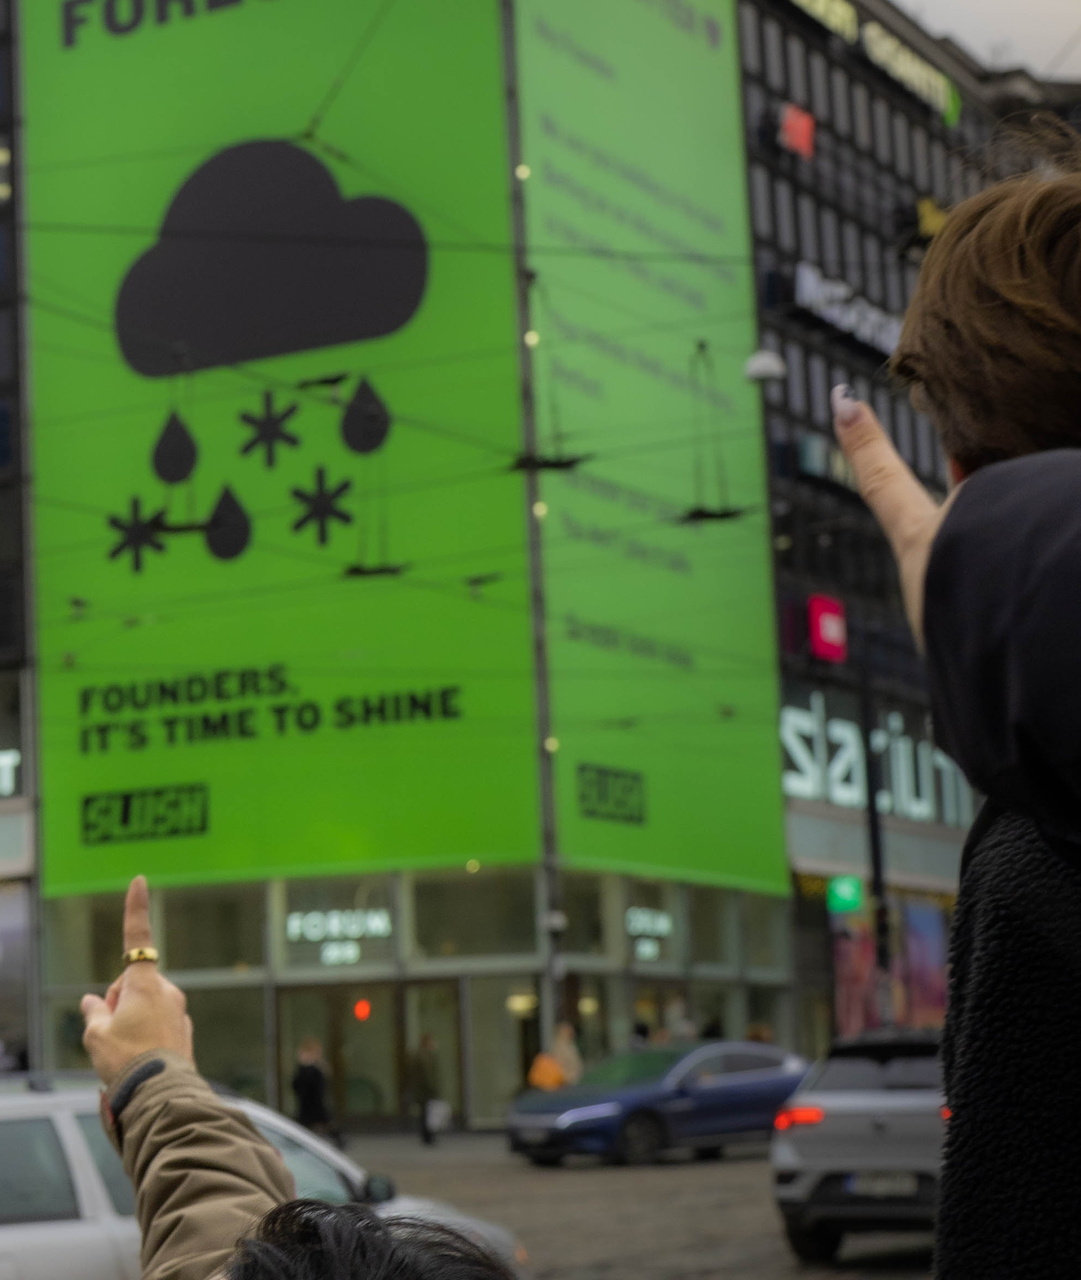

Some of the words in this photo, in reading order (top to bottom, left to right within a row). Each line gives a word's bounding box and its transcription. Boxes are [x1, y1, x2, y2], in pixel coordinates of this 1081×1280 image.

[79, 720, 150, 756] IT'S
[162, 707, 259, 747] TIME
[271, 700, 322, 736] TO
[333, 684, 463, 731] SHINE
[780, 690, 976, 827] staiu
